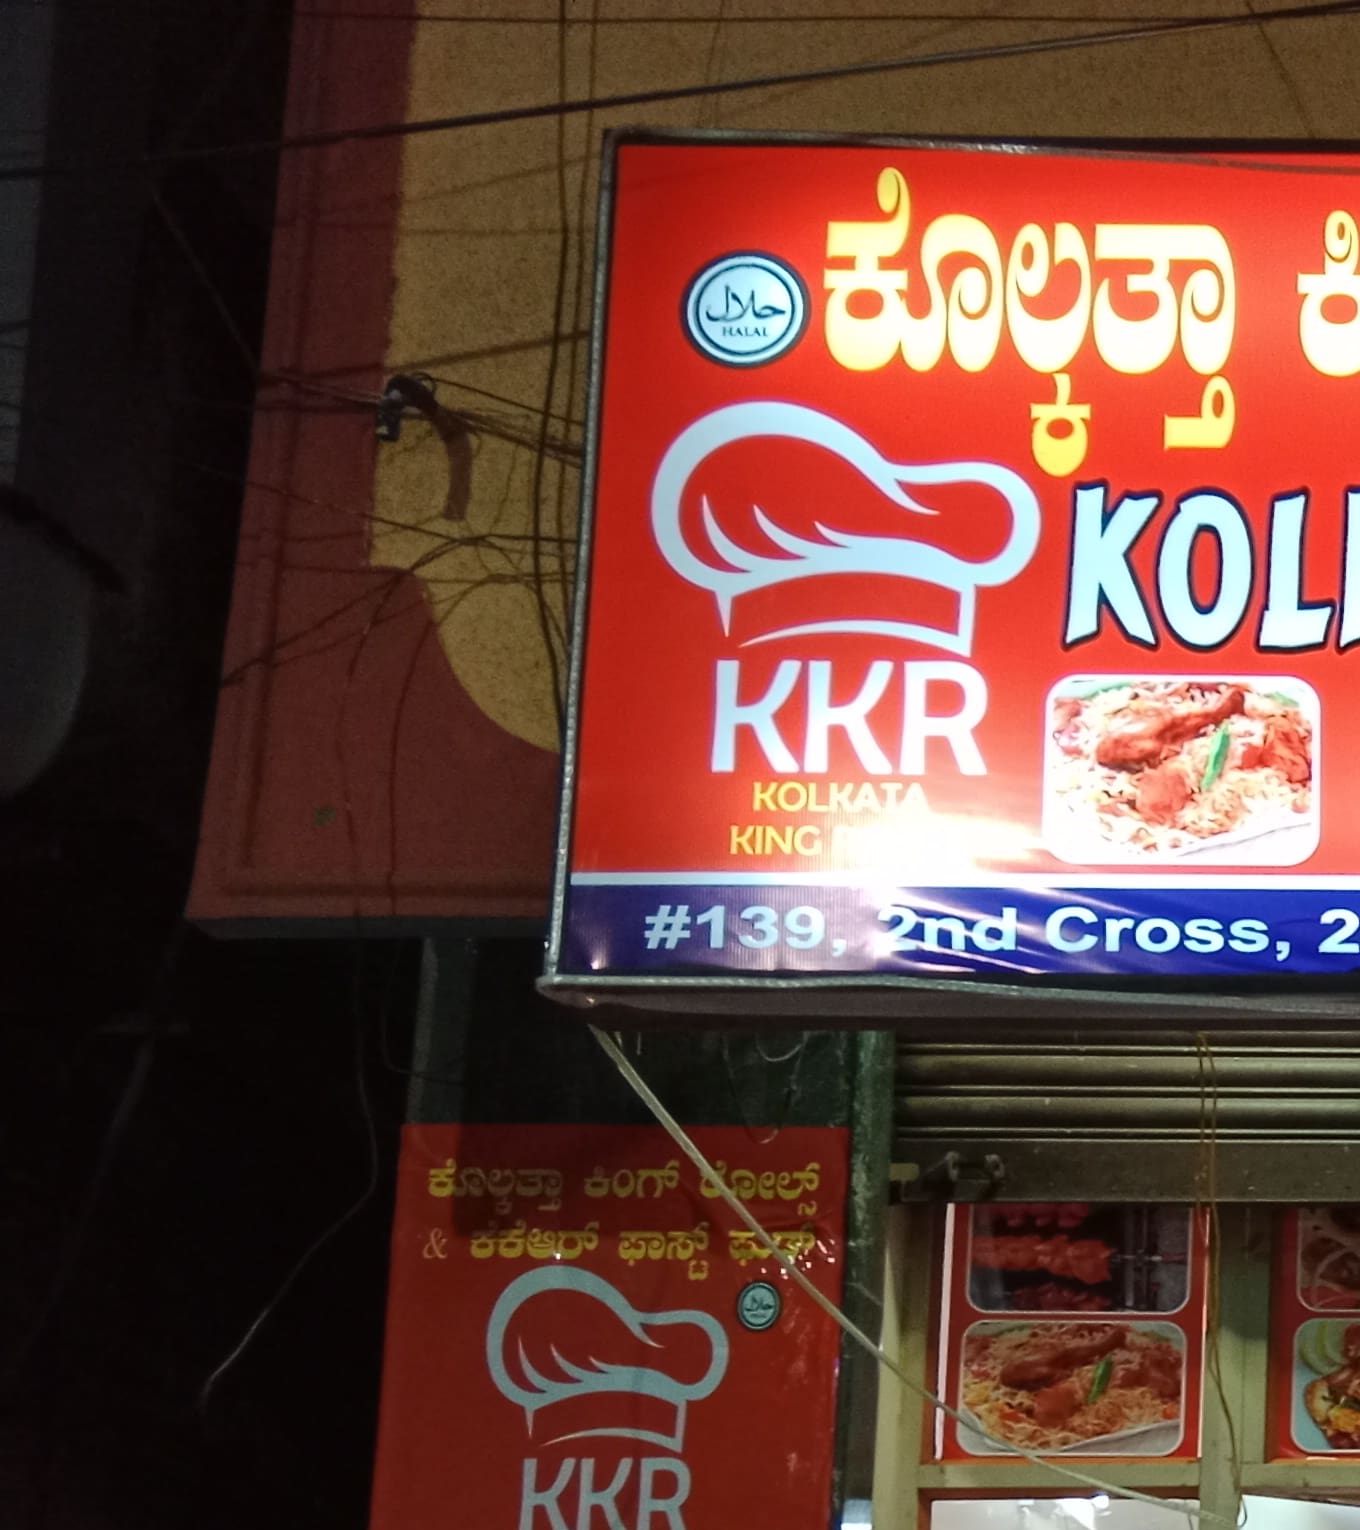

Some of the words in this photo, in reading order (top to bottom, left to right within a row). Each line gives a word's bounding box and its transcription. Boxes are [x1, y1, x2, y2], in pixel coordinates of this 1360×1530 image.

[706, 284, 787, 322] حلال
[823, 167, 1236, 476] ಕೊಲ್ಕತ್ತಾ
[721, 325, 769, 339] HALAL
[711, 660, 988, 776] KKR
[752, 782, 928, 812] KOLKATA
[644, 904, 846, 957] #139,
[878, 904, 1017, 954] 2nd
[1046, 907, 1291, 960] Cross,
[423, 1229, 448, 1259] &
